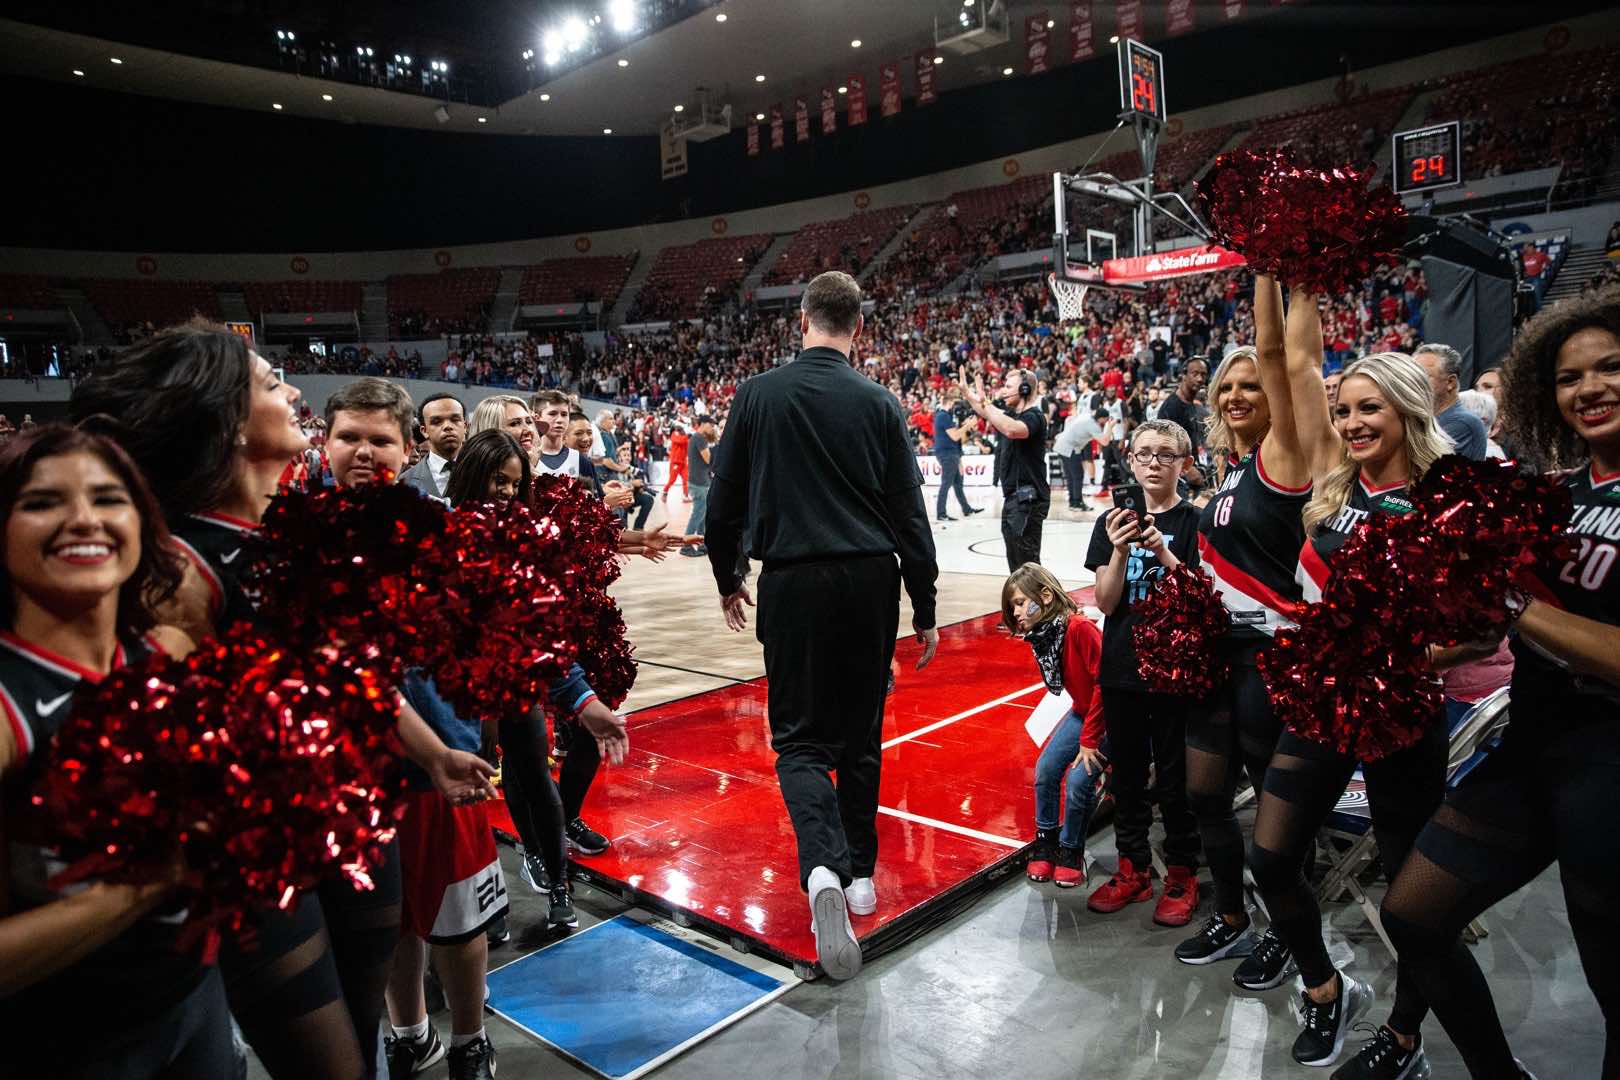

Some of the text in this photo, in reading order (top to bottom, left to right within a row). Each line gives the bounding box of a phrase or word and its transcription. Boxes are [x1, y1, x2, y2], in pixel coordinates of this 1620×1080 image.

[1133, 73, 1155, 113] 24
[1411, 154, 1446, 182] 24
[1214, 495, 1234, 527] 16
[1560, 538, 1617, 590] 20
